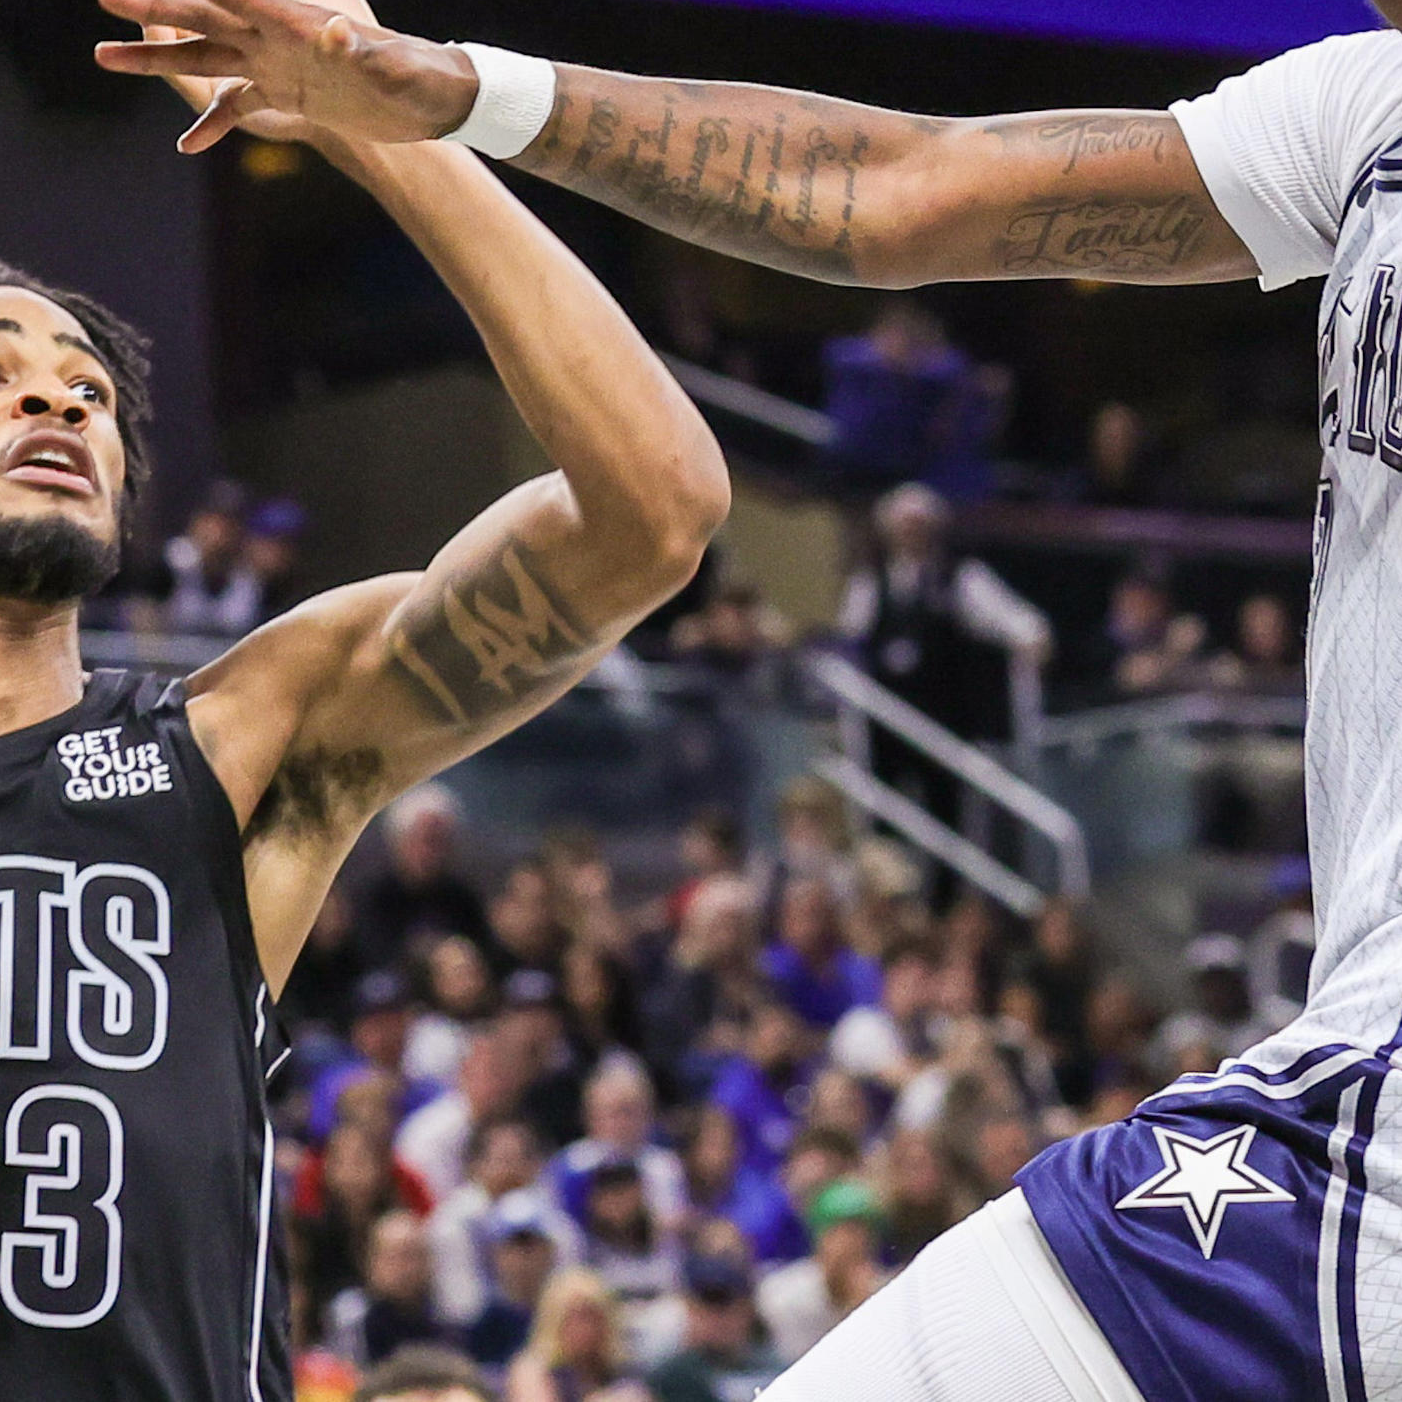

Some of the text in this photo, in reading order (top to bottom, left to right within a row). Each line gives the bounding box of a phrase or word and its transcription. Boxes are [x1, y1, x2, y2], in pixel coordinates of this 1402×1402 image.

[57, 725, 123, 756] GET
[60, 742, 162, 778] YOUR
[65, 764, 174, 802] GUIDE
